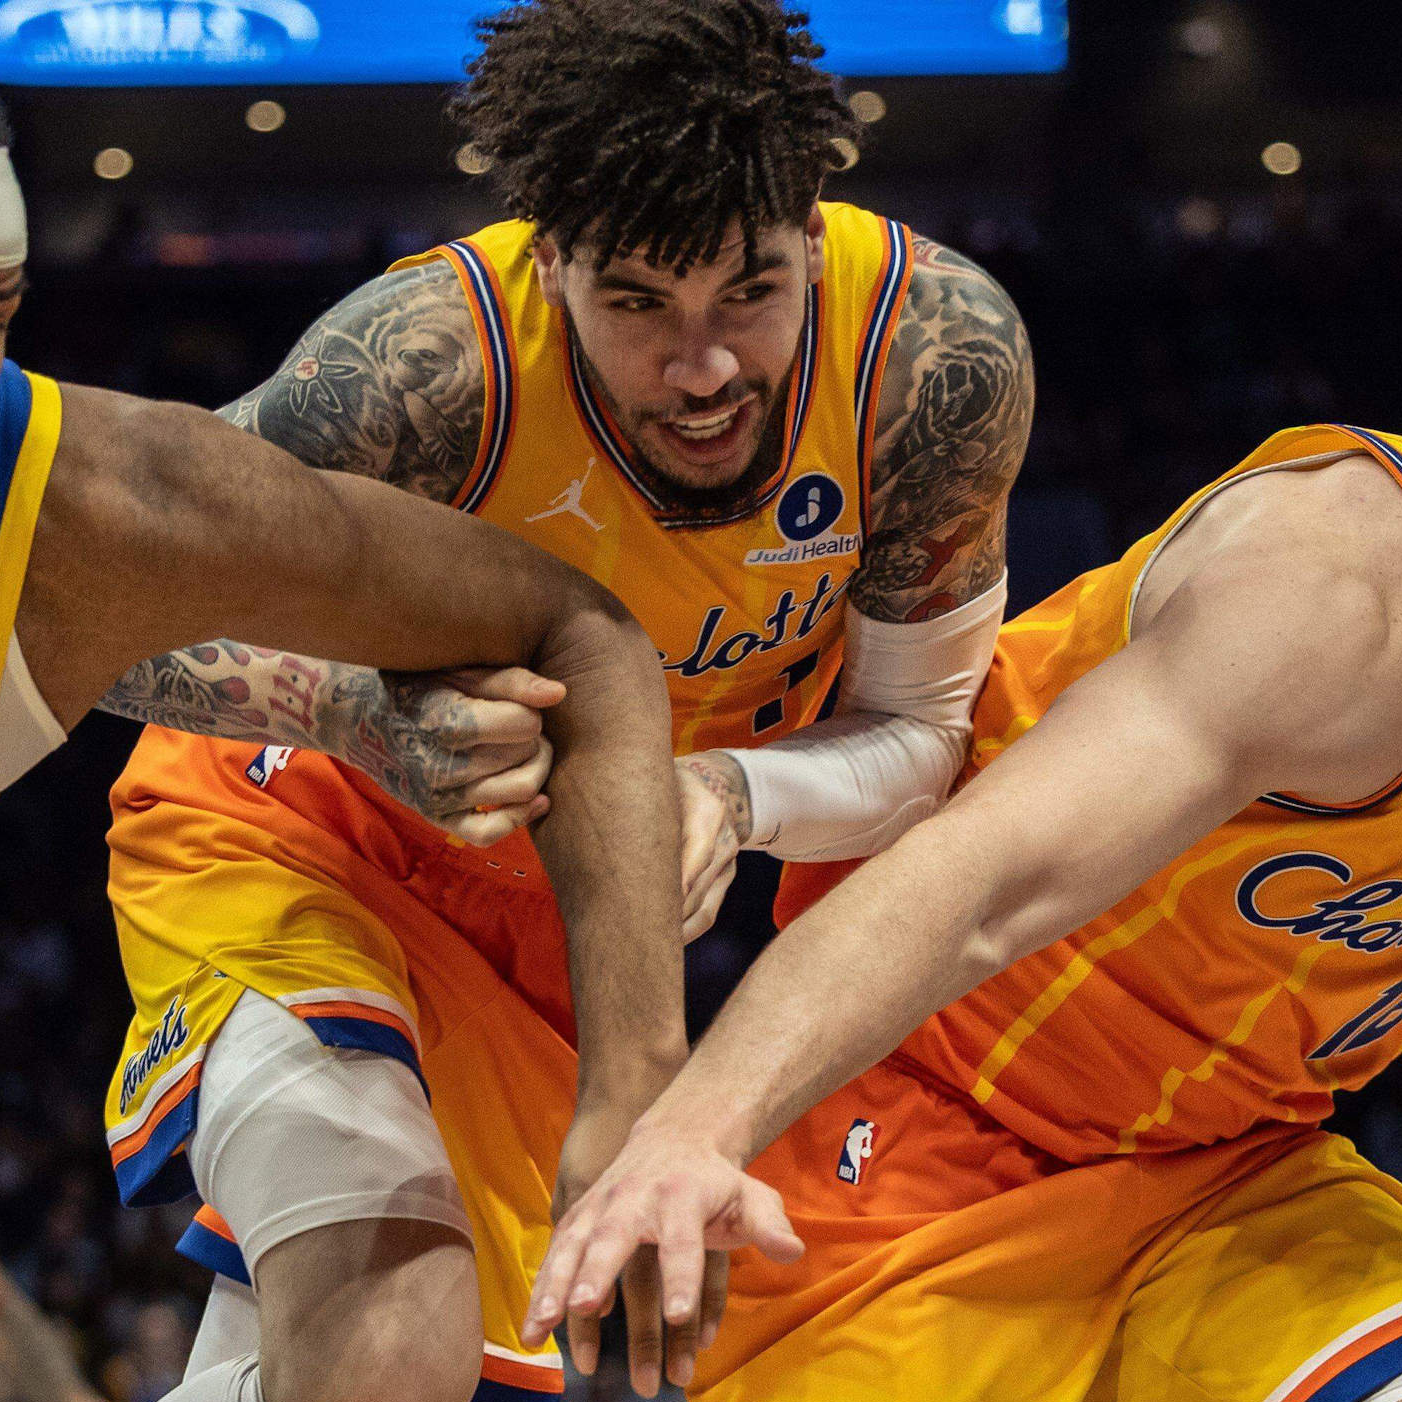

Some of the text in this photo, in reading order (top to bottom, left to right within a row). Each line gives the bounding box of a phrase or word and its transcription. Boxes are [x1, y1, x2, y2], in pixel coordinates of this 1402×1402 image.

[747, 546, 799, 563] Judi
[247, 764, 265, 783] NBA
[838, 1164, 855, 1181] NBA
